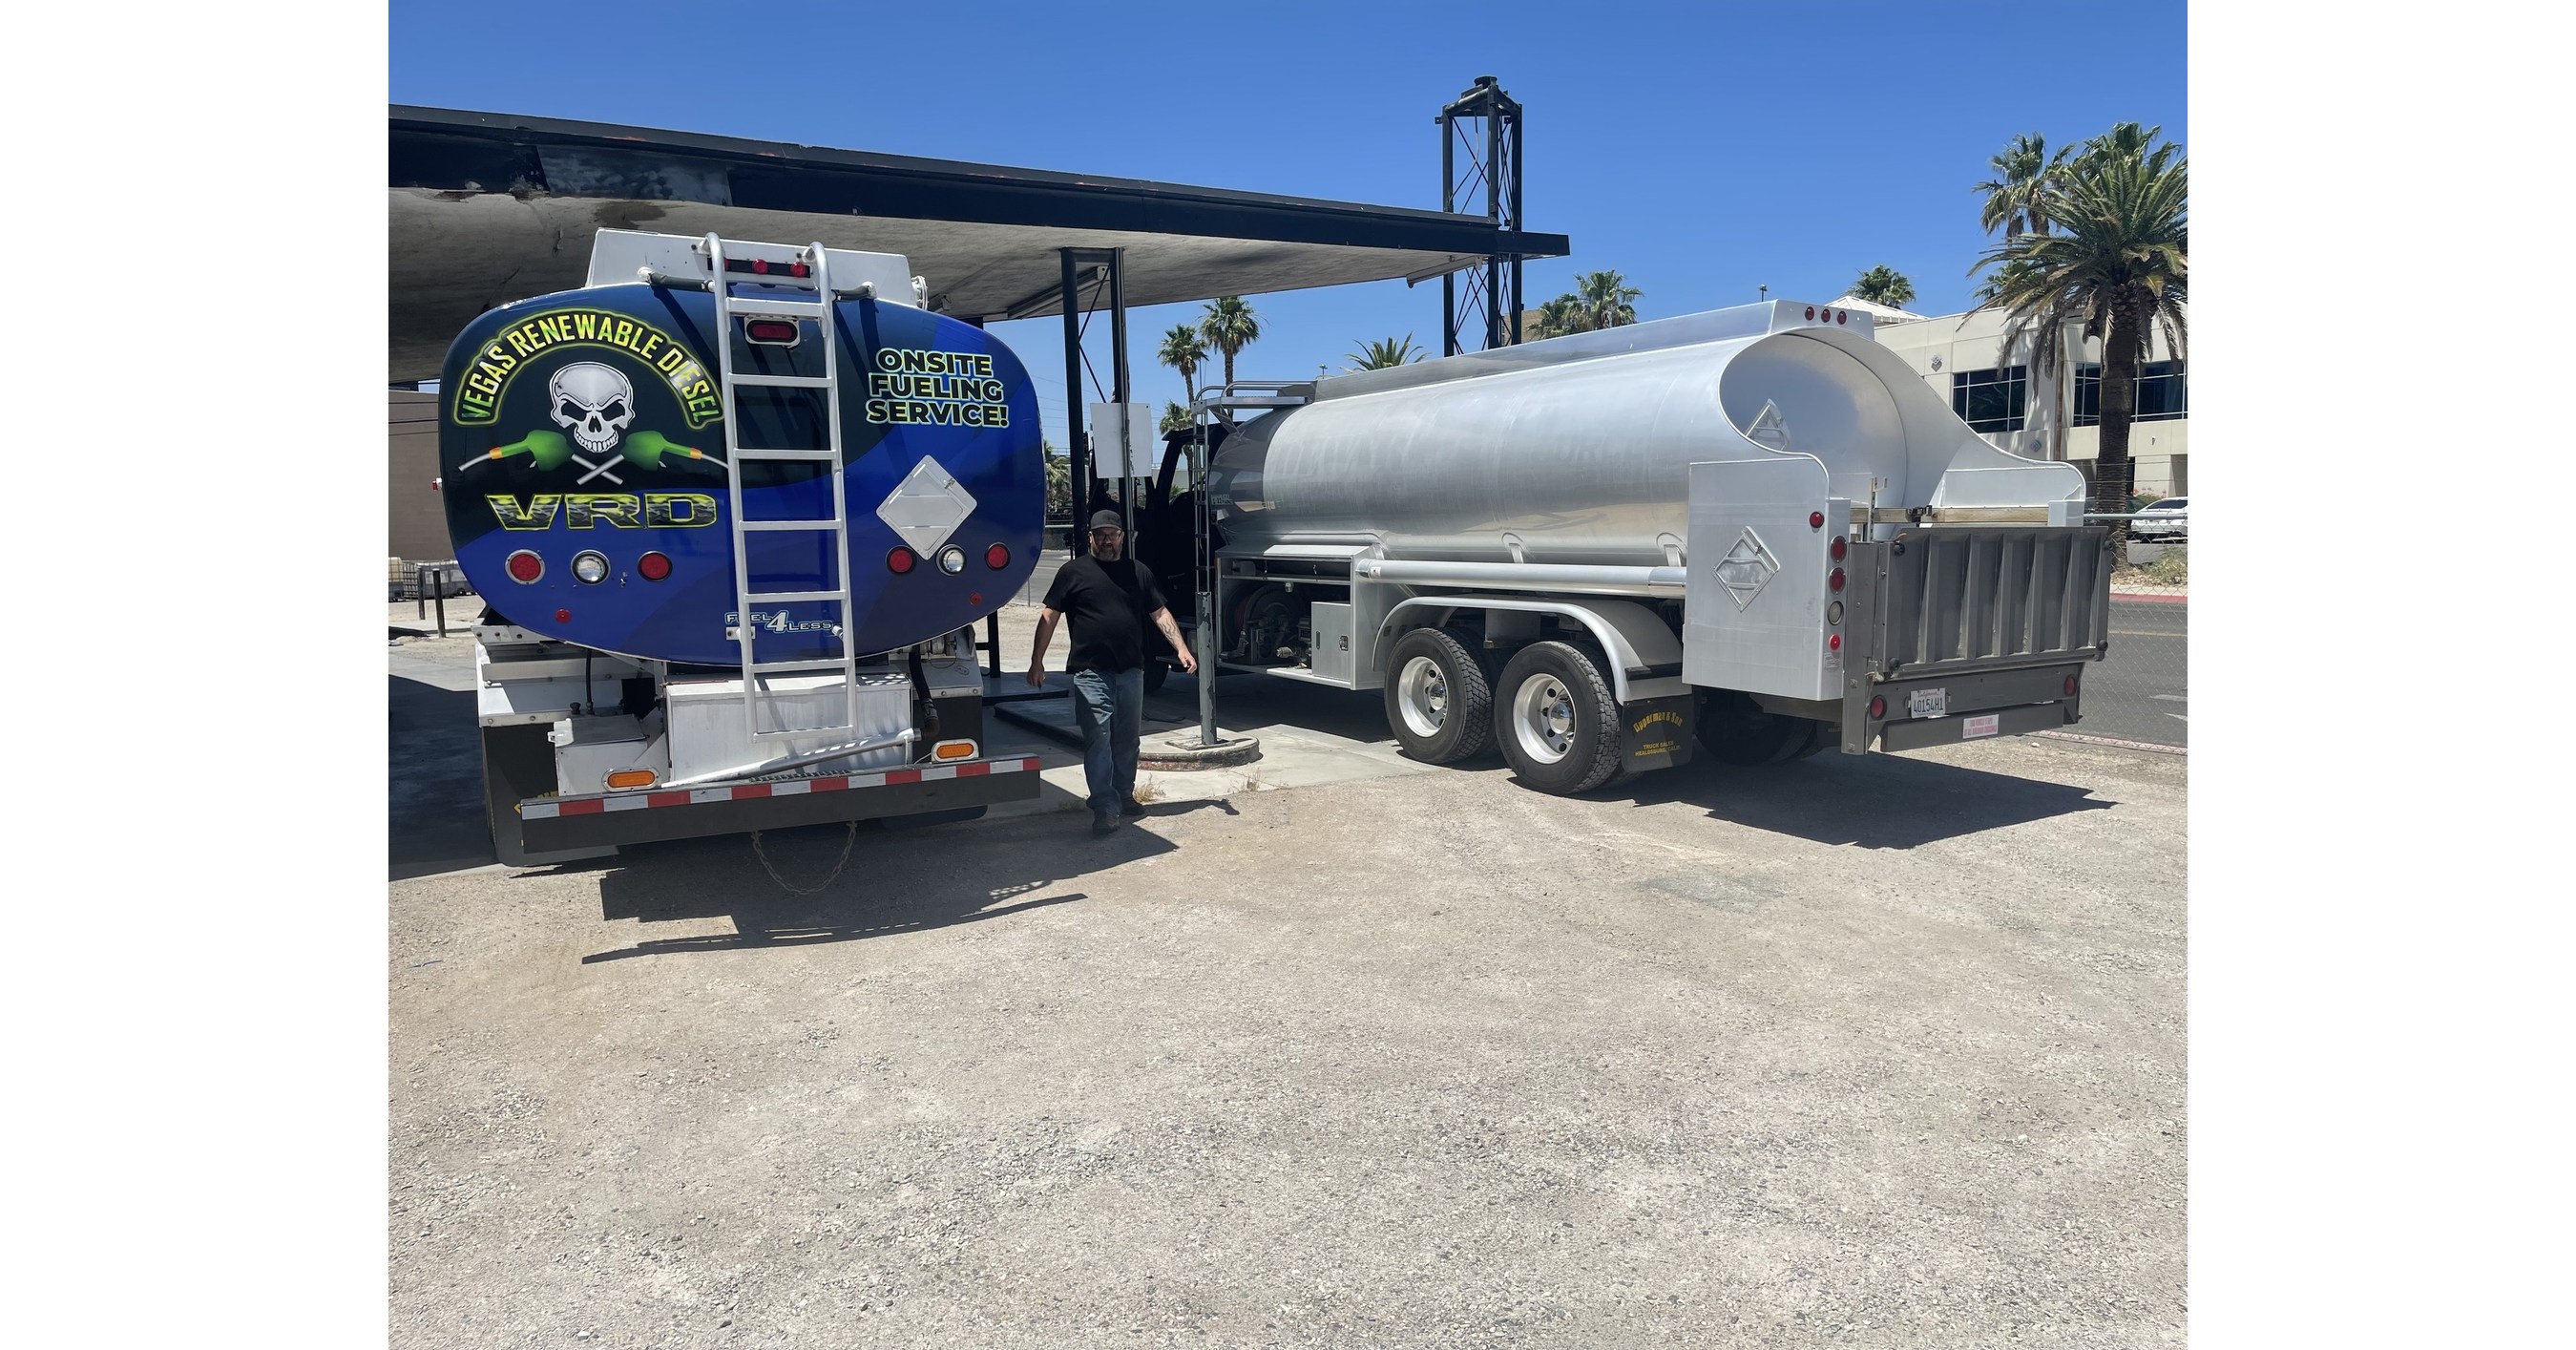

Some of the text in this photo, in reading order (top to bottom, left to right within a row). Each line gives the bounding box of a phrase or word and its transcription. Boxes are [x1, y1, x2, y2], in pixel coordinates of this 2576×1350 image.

[462, 314, 721, 423] VEGAS RENEWABLE DIESEL
[876, 348, 994, 378] ONSITE
[869, 372, 1004, 403] FUELING
[866, 398, 1010, 428] SERVICE!
[484, 493, 718, 531] VRD
[765, 610, 788, 633] 4
[787, 621, 833, 631] LESS
